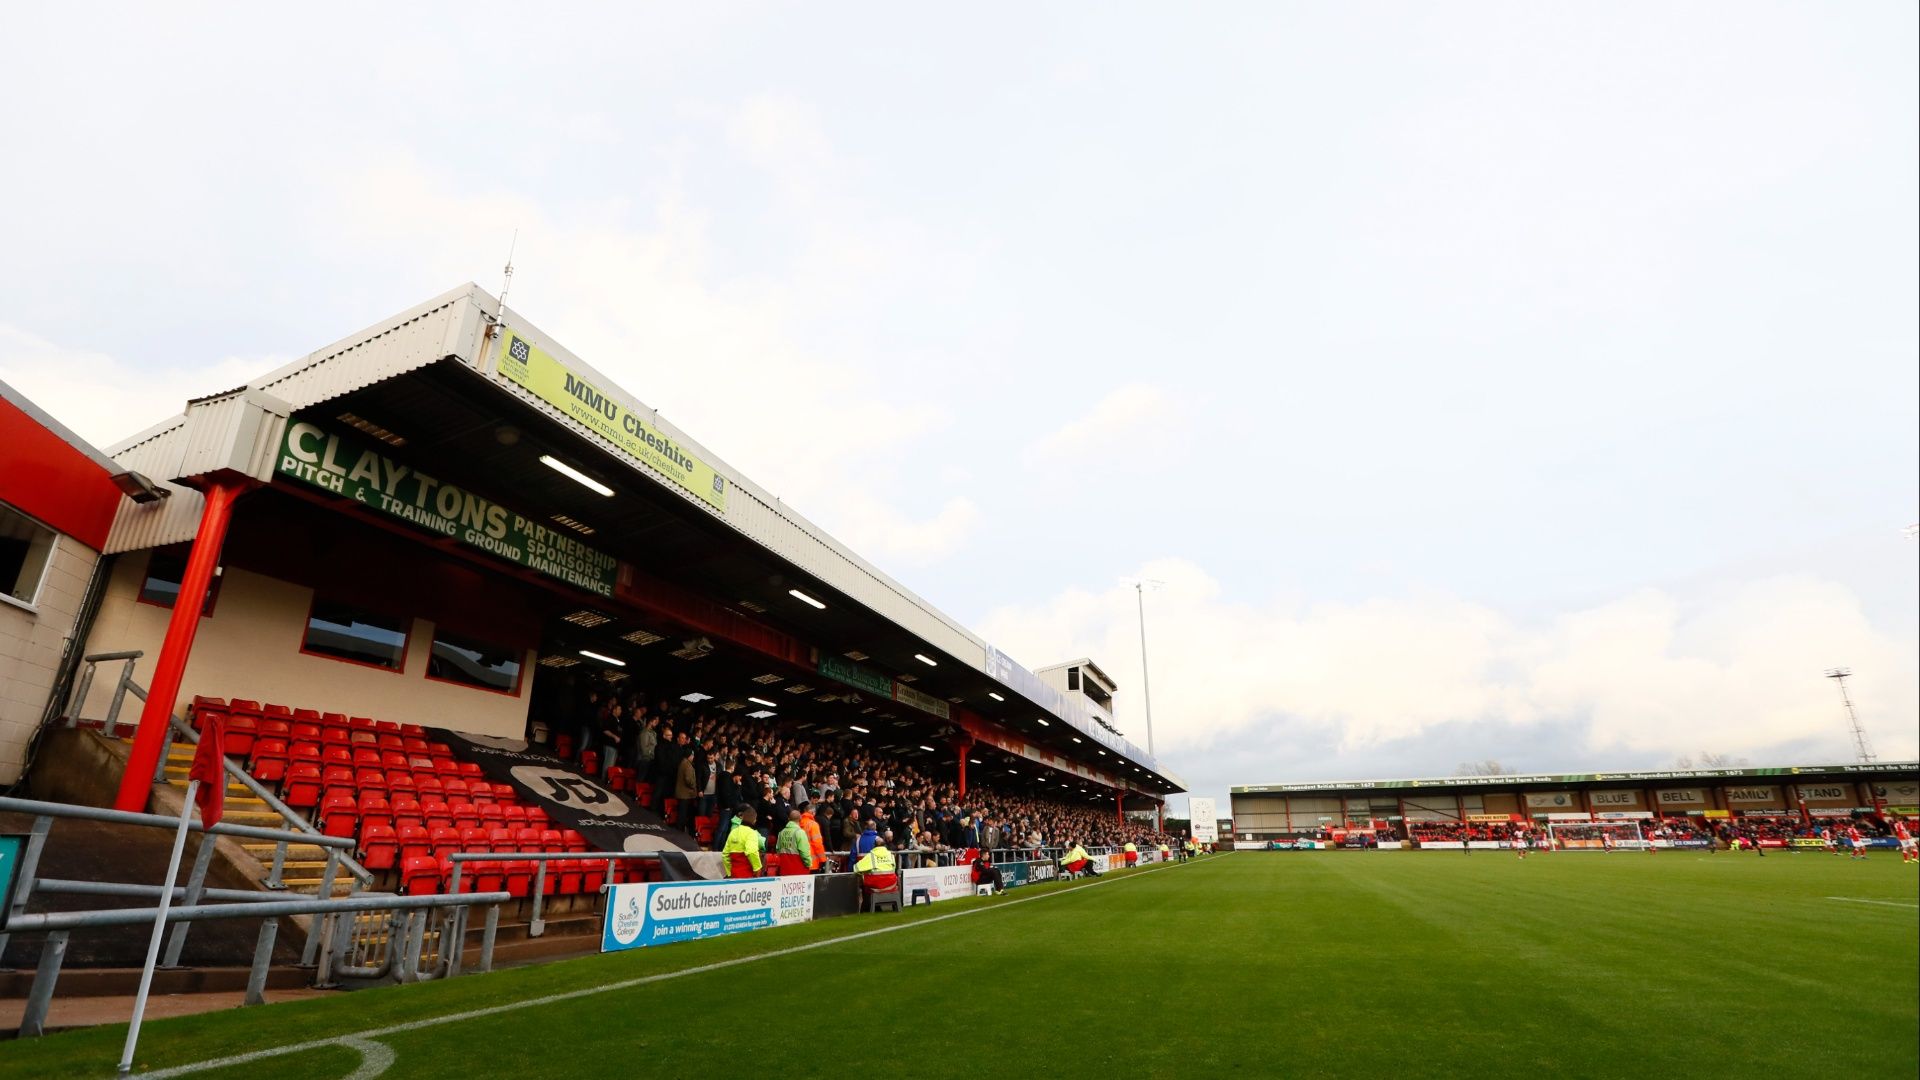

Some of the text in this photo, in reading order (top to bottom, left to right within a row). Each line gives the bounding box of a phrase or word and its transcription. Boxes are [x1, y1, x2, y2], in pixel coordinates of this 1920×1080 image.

[564, 372, 618, 421] MMU
[570, 402, 686, 482] www.mmu.ac.uk/cheshire
[623, 413, 694, 473] Cheshire
[287, 422, 508, 539] CLAYTONS
[281, 456, 611, 596] PITCH & TRAINING GROUND MAINTENANCE
[513, 515, 617, 571] PARTNERSHIP
[527, 539, 602, 579] SPONSORS
[1629, 772, 1671, 780] Independent
[542, 776, 609, 804] JD
[1597, 792, 1629, 804] BLUE
[1662, 792, 1695, 802] BELL
[1727, 789, 1769, 801] FAMILY
[1799, 788, 1841, 799] STAND
[781, 881, 806, 896] INSPIRE
[944, 873, 958, 886] 01270
[656, 891, 691, 912] South
[693, 890, 737, 909] Cheshire
[780, 895, 804, 908] BELIEVE
[780, 908, 804, 919] ACHIEVE
[652, 921, 720, 939] Join a winning team
